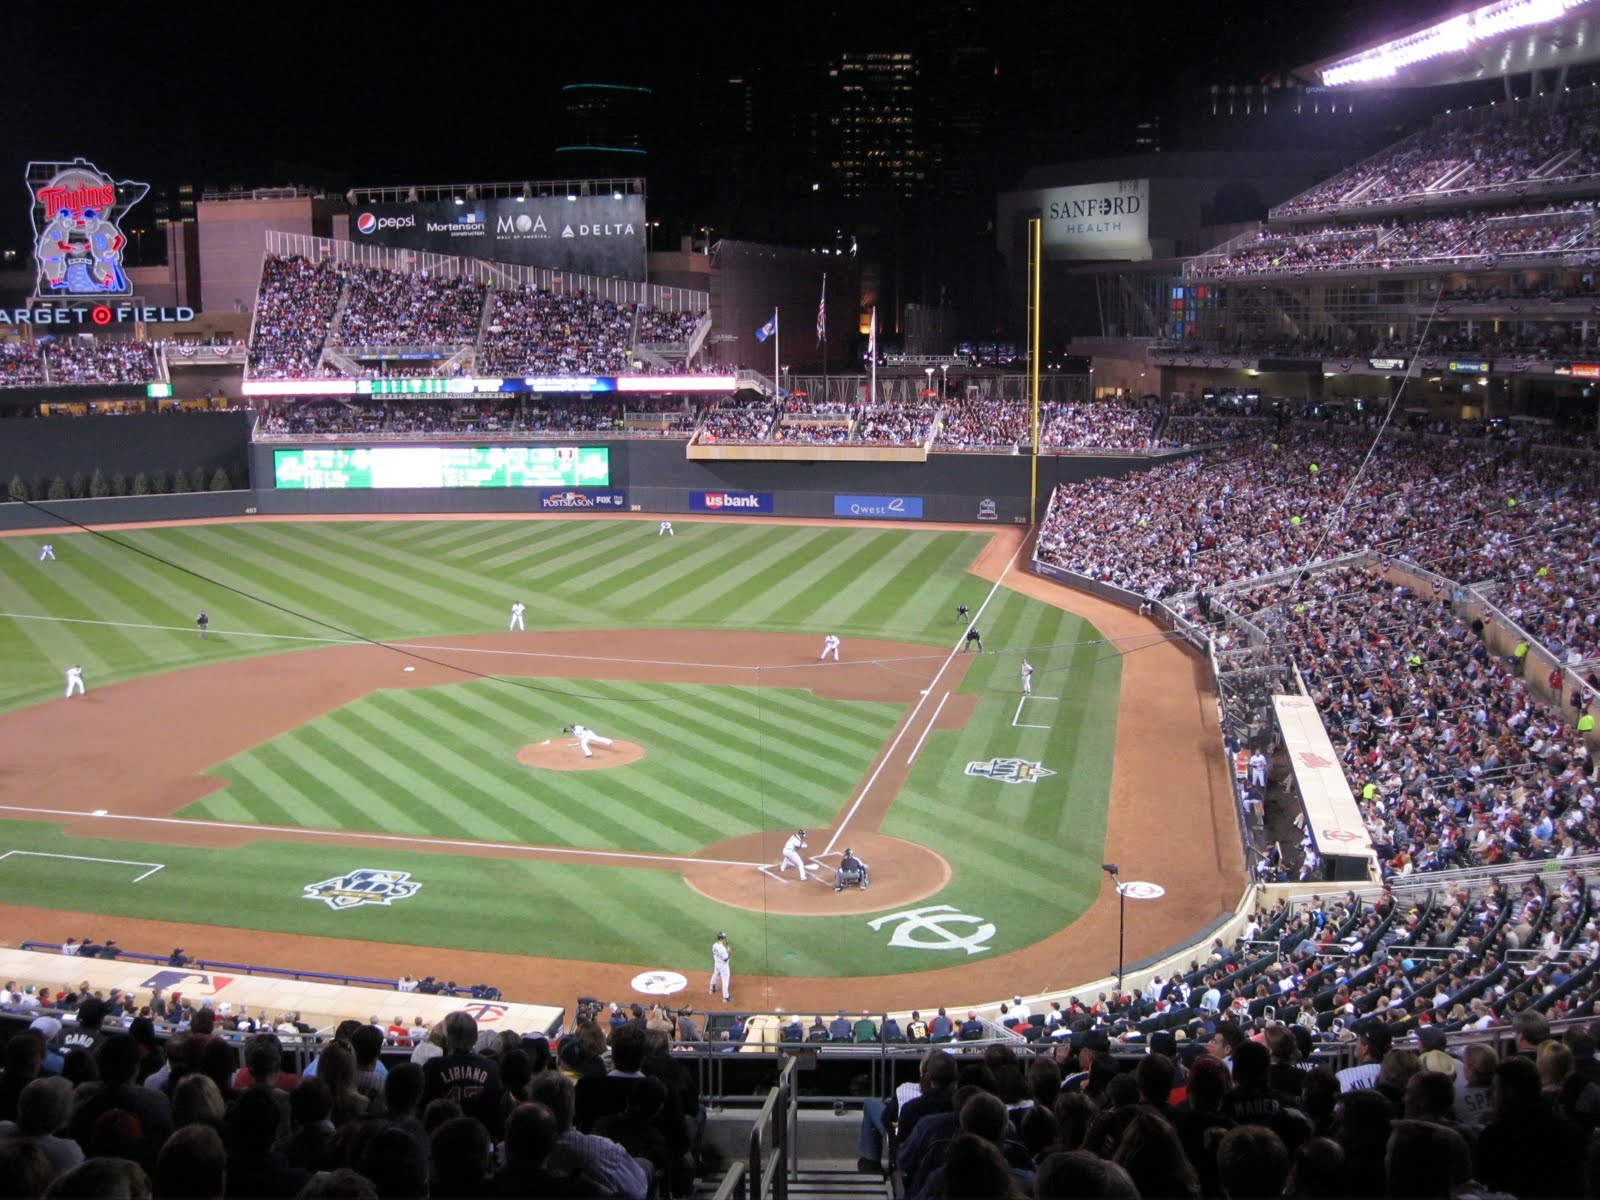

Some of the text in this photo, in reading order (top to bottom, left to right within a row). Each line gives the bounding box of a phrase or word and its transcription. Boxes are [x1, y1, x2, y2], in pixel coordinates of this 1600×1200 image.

[37, 183, 115, 219] Twins
[1050, 195, 1140, 220] SANFORD
[378, 214, 416, 230] pepsi
[427, 222, 485, 232] Mortenson
[497, 214, 547, 233] MOA
[580, 223, 635, 236] DELTA
[1067, 222, 1122, 234] HEALTH
[117, 307, 195, 322] FIELD
[543, 498, 594, 507] POSTSEASON
[596, 496, 611, 504] FOX
[851, 503, 885, 514] Qwest
[65, 1033, 94, 1048] CANO
[440, 1065, 488, 1084] LIRIANO
